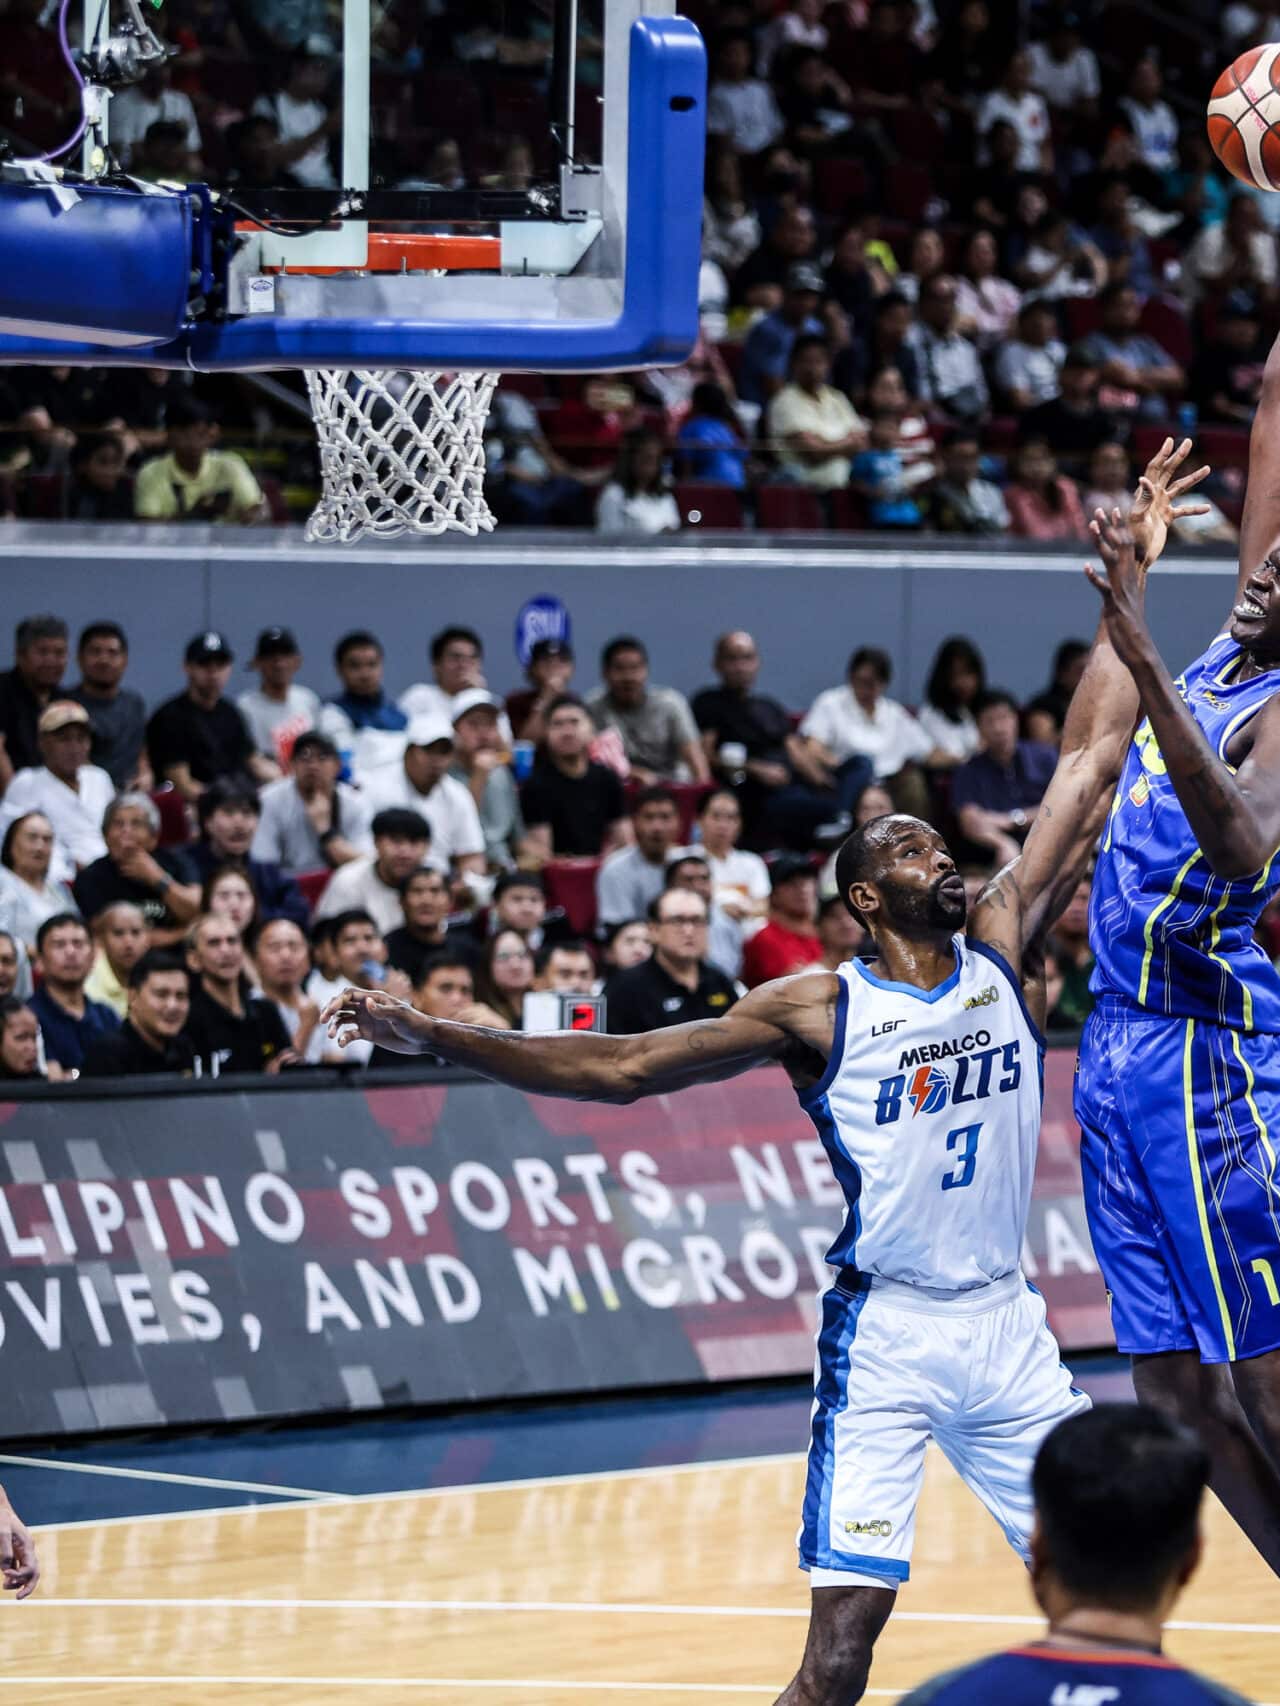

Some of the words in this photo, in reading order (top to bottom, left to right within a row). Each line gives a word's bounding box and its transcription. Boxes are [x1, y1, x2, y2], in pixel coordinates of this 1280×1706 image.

[873, 1039, 1022, 1126] BOLTS
[898, 1030, 991, 1070] MERALCO
[339, 1150, 707, 1239] SPORTS,
[729, 1142, 841, 1210] NE
[941, 1122, 985, 1192] 3
[0, 1270, 262, 1352] VIES,
[304, 1253, 481, 1334] AND
[1250, 1258, 1280, 1307] 1
